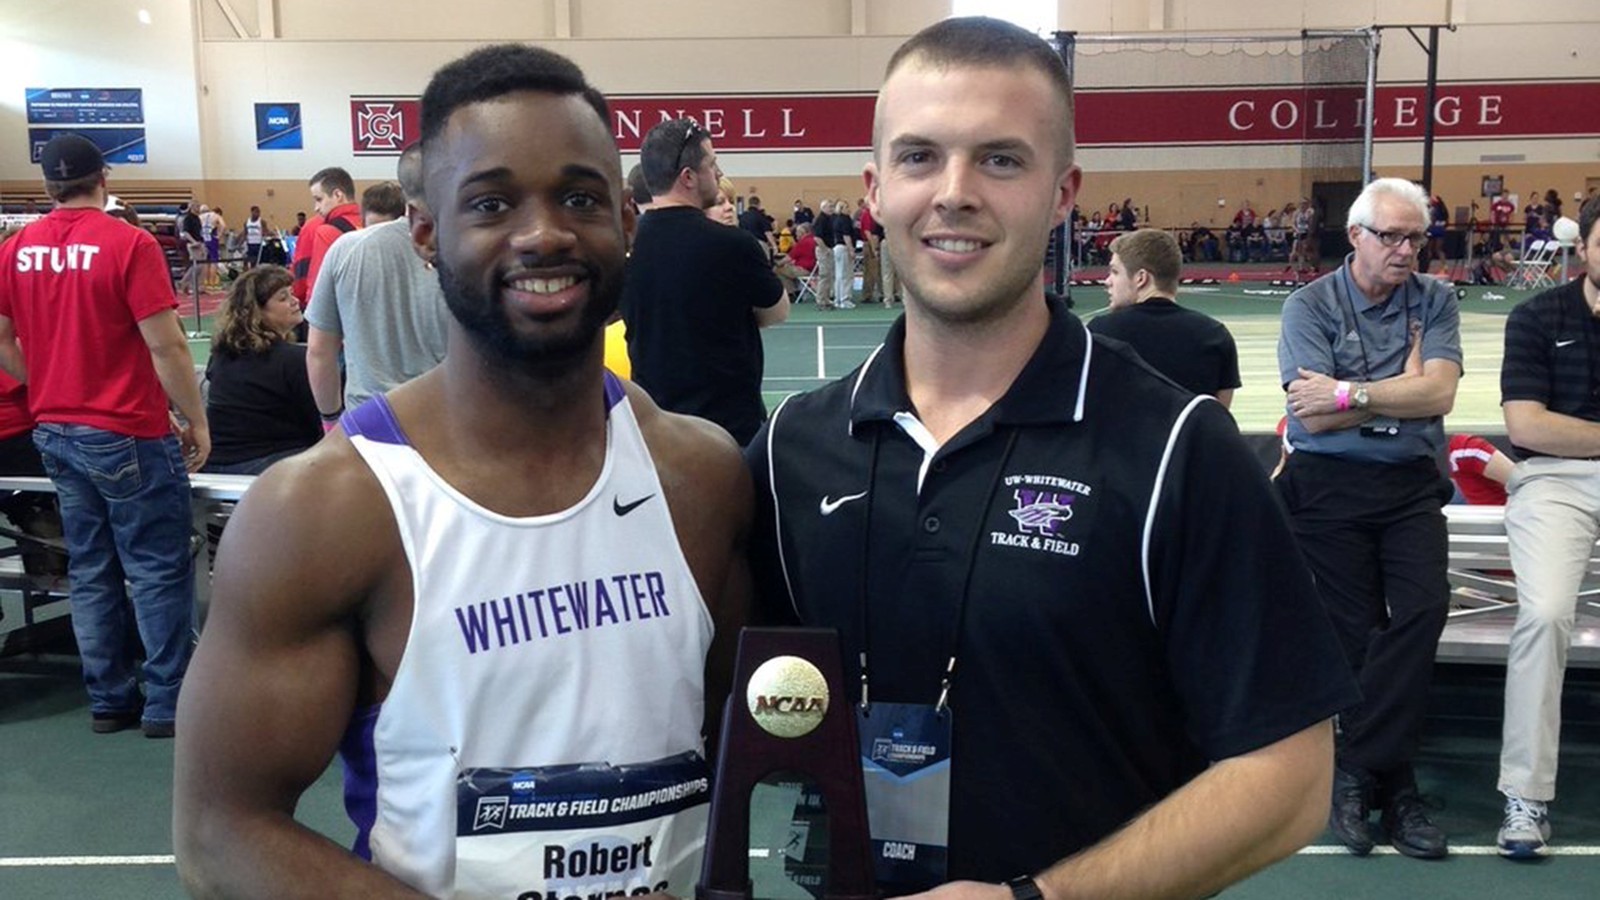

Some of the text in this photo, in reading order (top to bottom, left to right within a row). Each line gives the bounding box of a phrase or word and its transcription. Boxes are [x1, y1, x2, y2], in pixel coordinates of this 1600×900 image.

[1228, 95, 1504, 131] COLLEGE
[1005, 475, 1091, 496] UW-WHITEWATER
[991, 532, 1079, 556] TRACK & FIELD
[455, 571, 670, 655] WHITEWATER
[754, 695, 825, 716] NCAA
[512, 780, 536, 791] NCAA
[509, 804, 555, 820] TRACK
[556, 802, 568, 818] &
[569, 799, 608, 816] FIELD
[611, 778, 708, 812] CHAMPIONSHIPS
[543, 835, 653, 880] Robert
[883, 842, 916, 860] COACH
